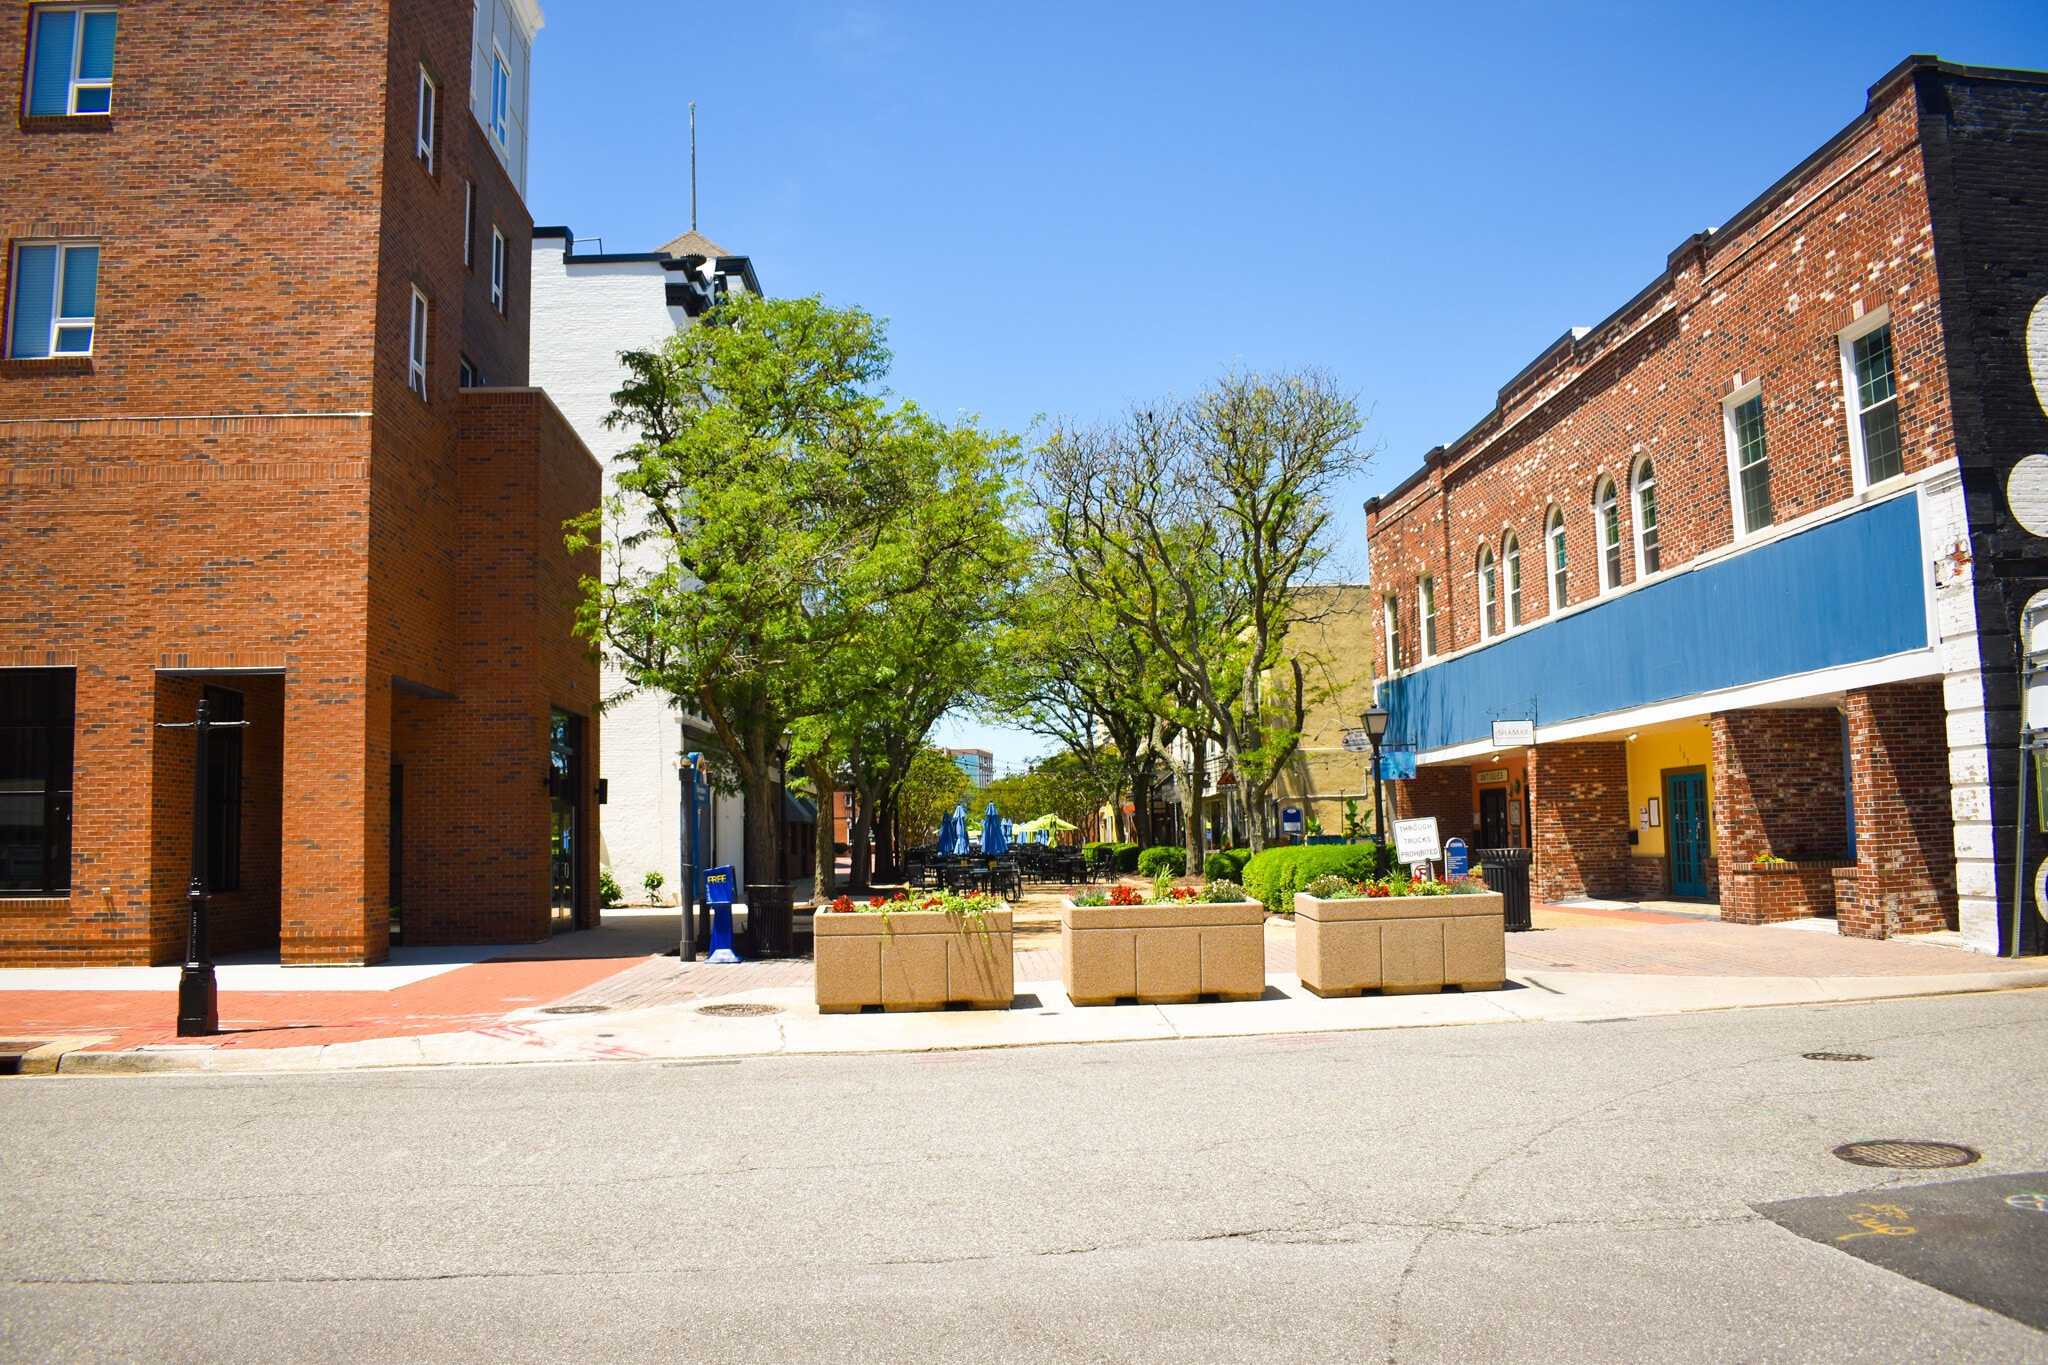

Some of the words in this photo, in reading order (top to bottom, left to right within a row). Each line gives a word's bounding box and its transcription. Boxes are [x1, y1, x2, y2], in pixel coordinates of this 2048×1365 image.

[1399, 823, 1432, 832] THROUGH
[1404, 836, 1432, 845] TRUCKS
[1400, 848, 1438, 858] PROHIBITED
[707, 874, 727, 883] FREE
